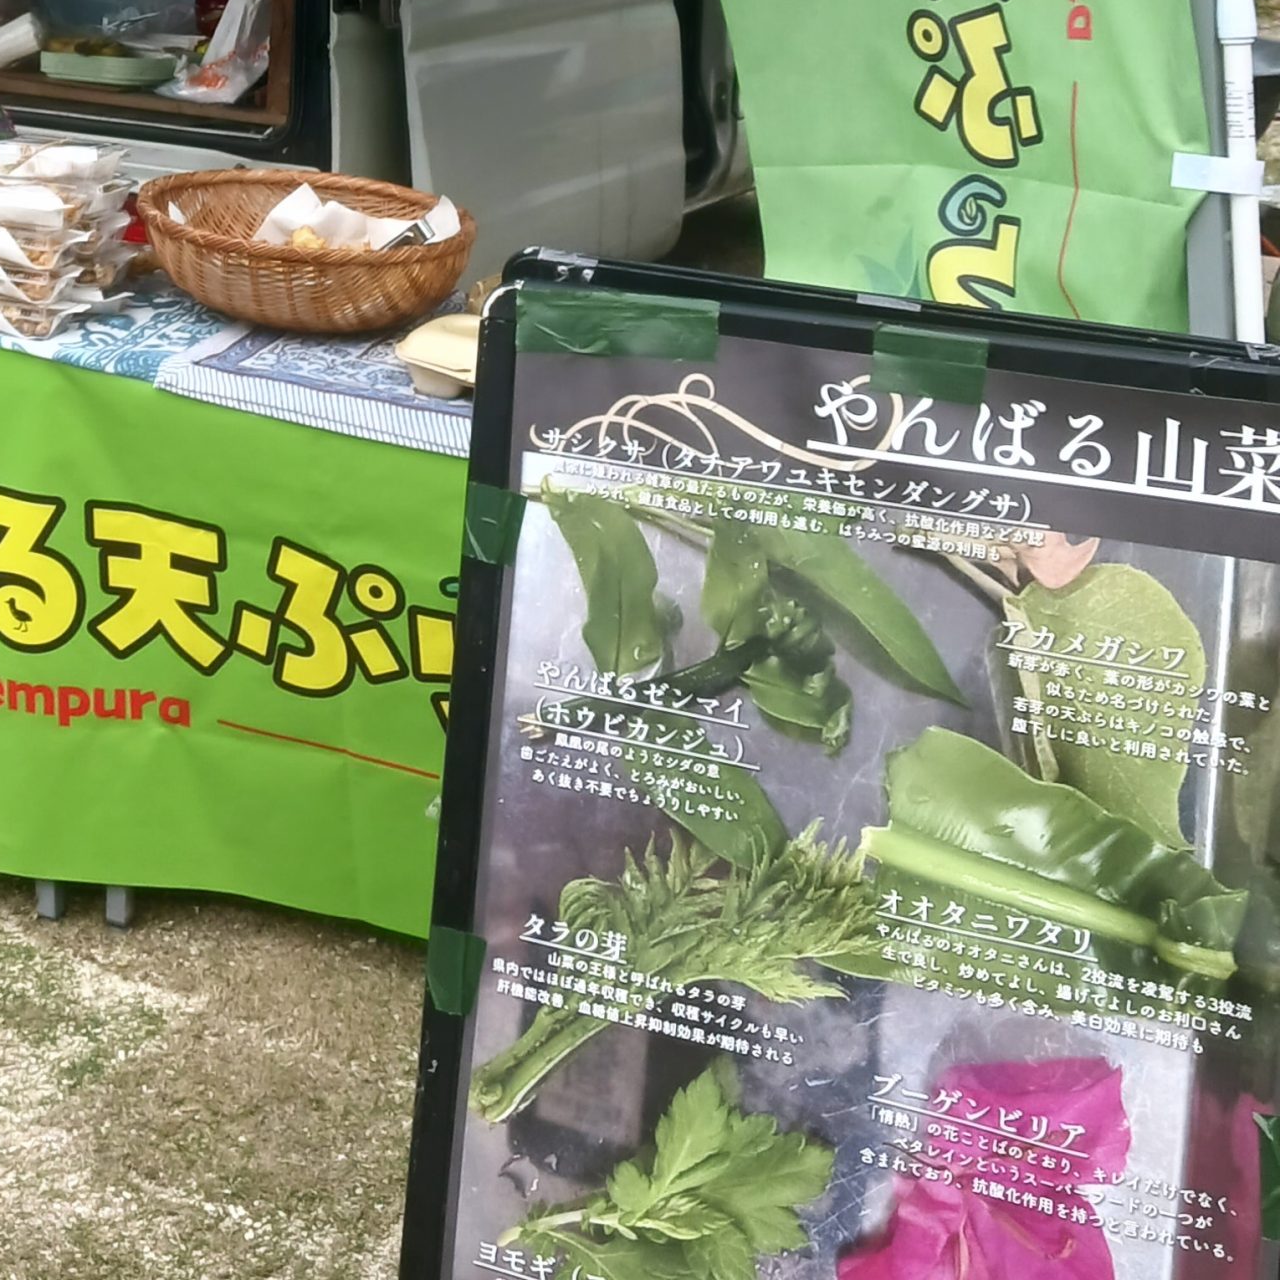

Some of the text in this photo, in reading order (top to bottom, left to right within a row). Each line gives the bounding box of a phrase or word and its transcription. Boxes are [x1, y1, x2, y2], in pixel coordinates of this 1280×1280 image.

[814, 379, 1280, 499] やんばる山菜
[1000, 620, 1187, 671] アカメガシワ
[536, 661, 744, 724] やんばるゼンマイ
[523, 913, 628, 960] タラの芽
[878, 888, 1091, 955] オオタニワタリ
[548, 951, 747, 1012] 山菜の王様と呼ばれるタラの芽
[872, 1072, 1086, 1149] ブーゲンビリア
